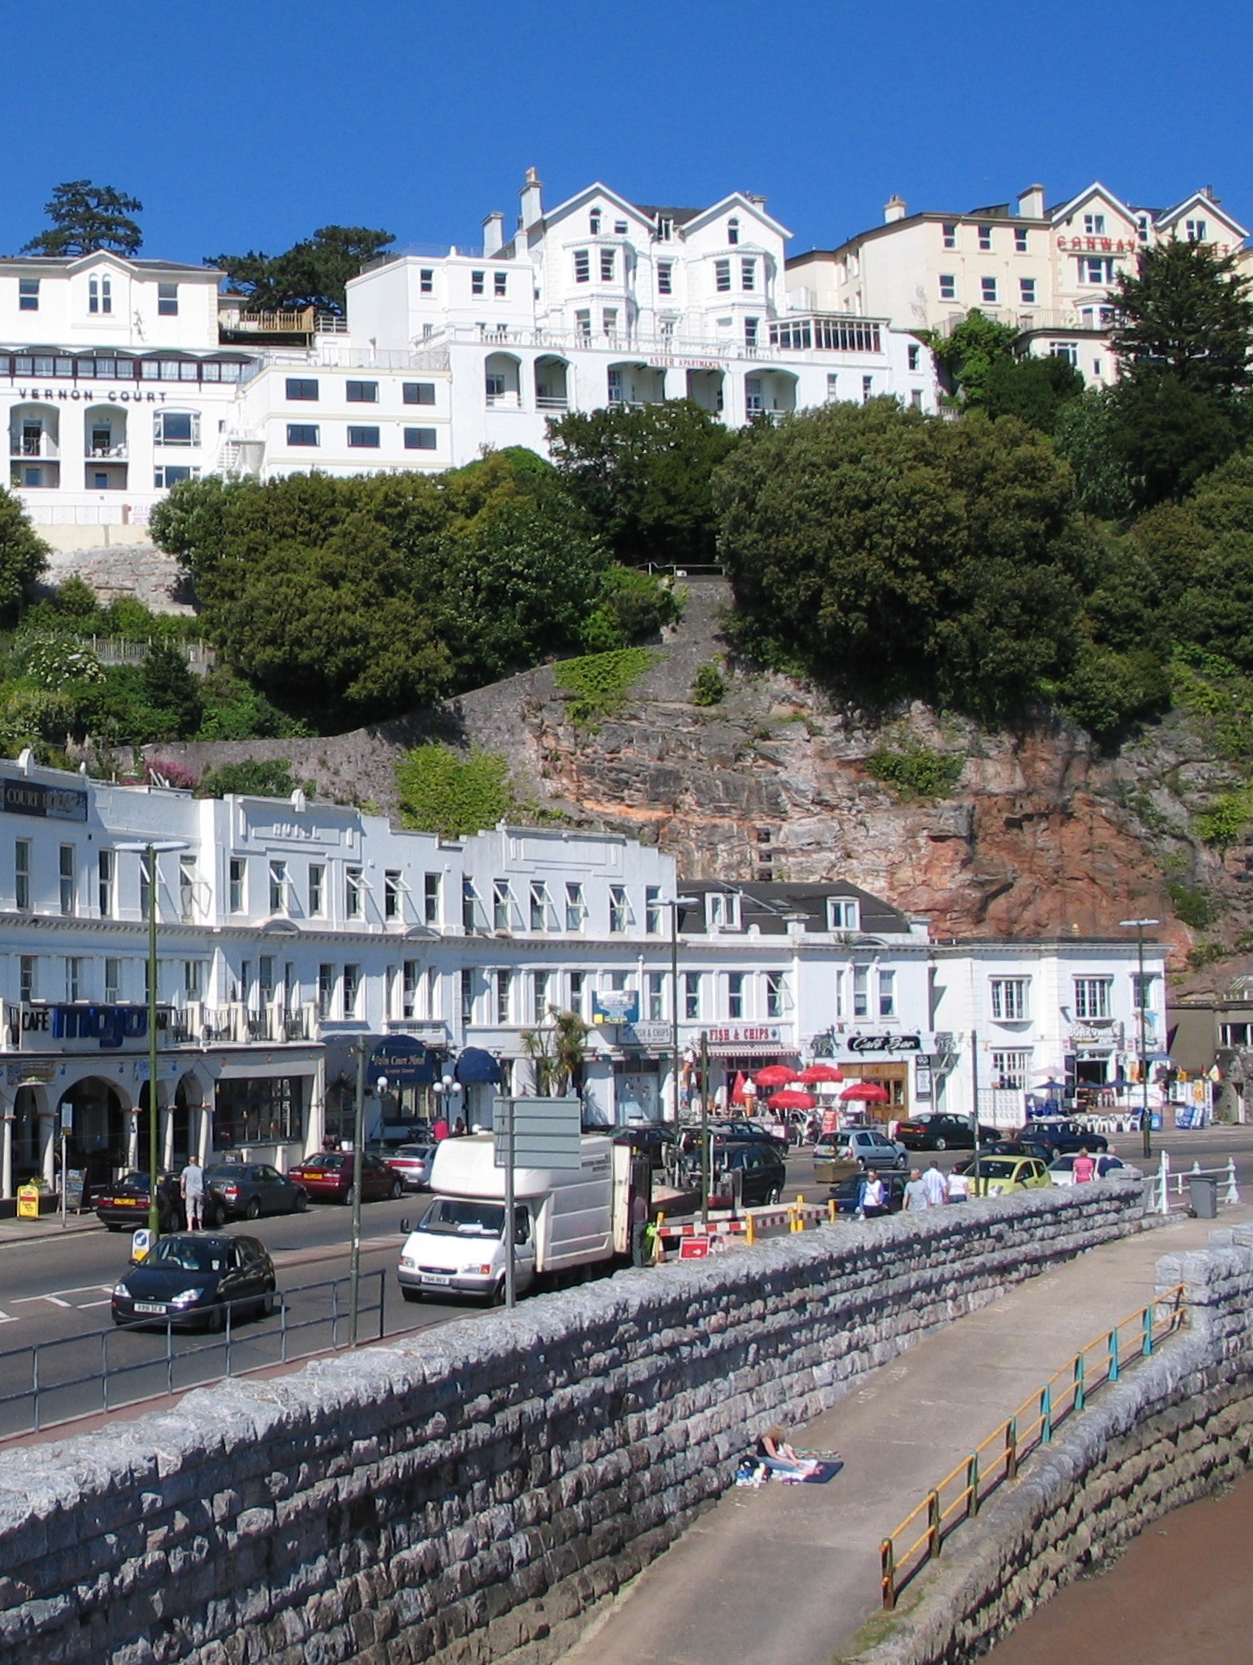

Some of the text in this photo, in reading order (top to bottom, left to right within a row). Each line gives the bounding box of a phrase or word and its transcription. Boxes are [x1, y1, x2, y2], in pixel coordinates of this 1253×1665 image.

[1057, 235, 1136, 253] CONWAY
[18, 388, 168, 403] VERNON COURT
[22, 1008, 49, 1031] CAFÉ
[709, 1028, 769, 1042] FISH & CHIPS
[885, 1036, 916, 1050] Bar
